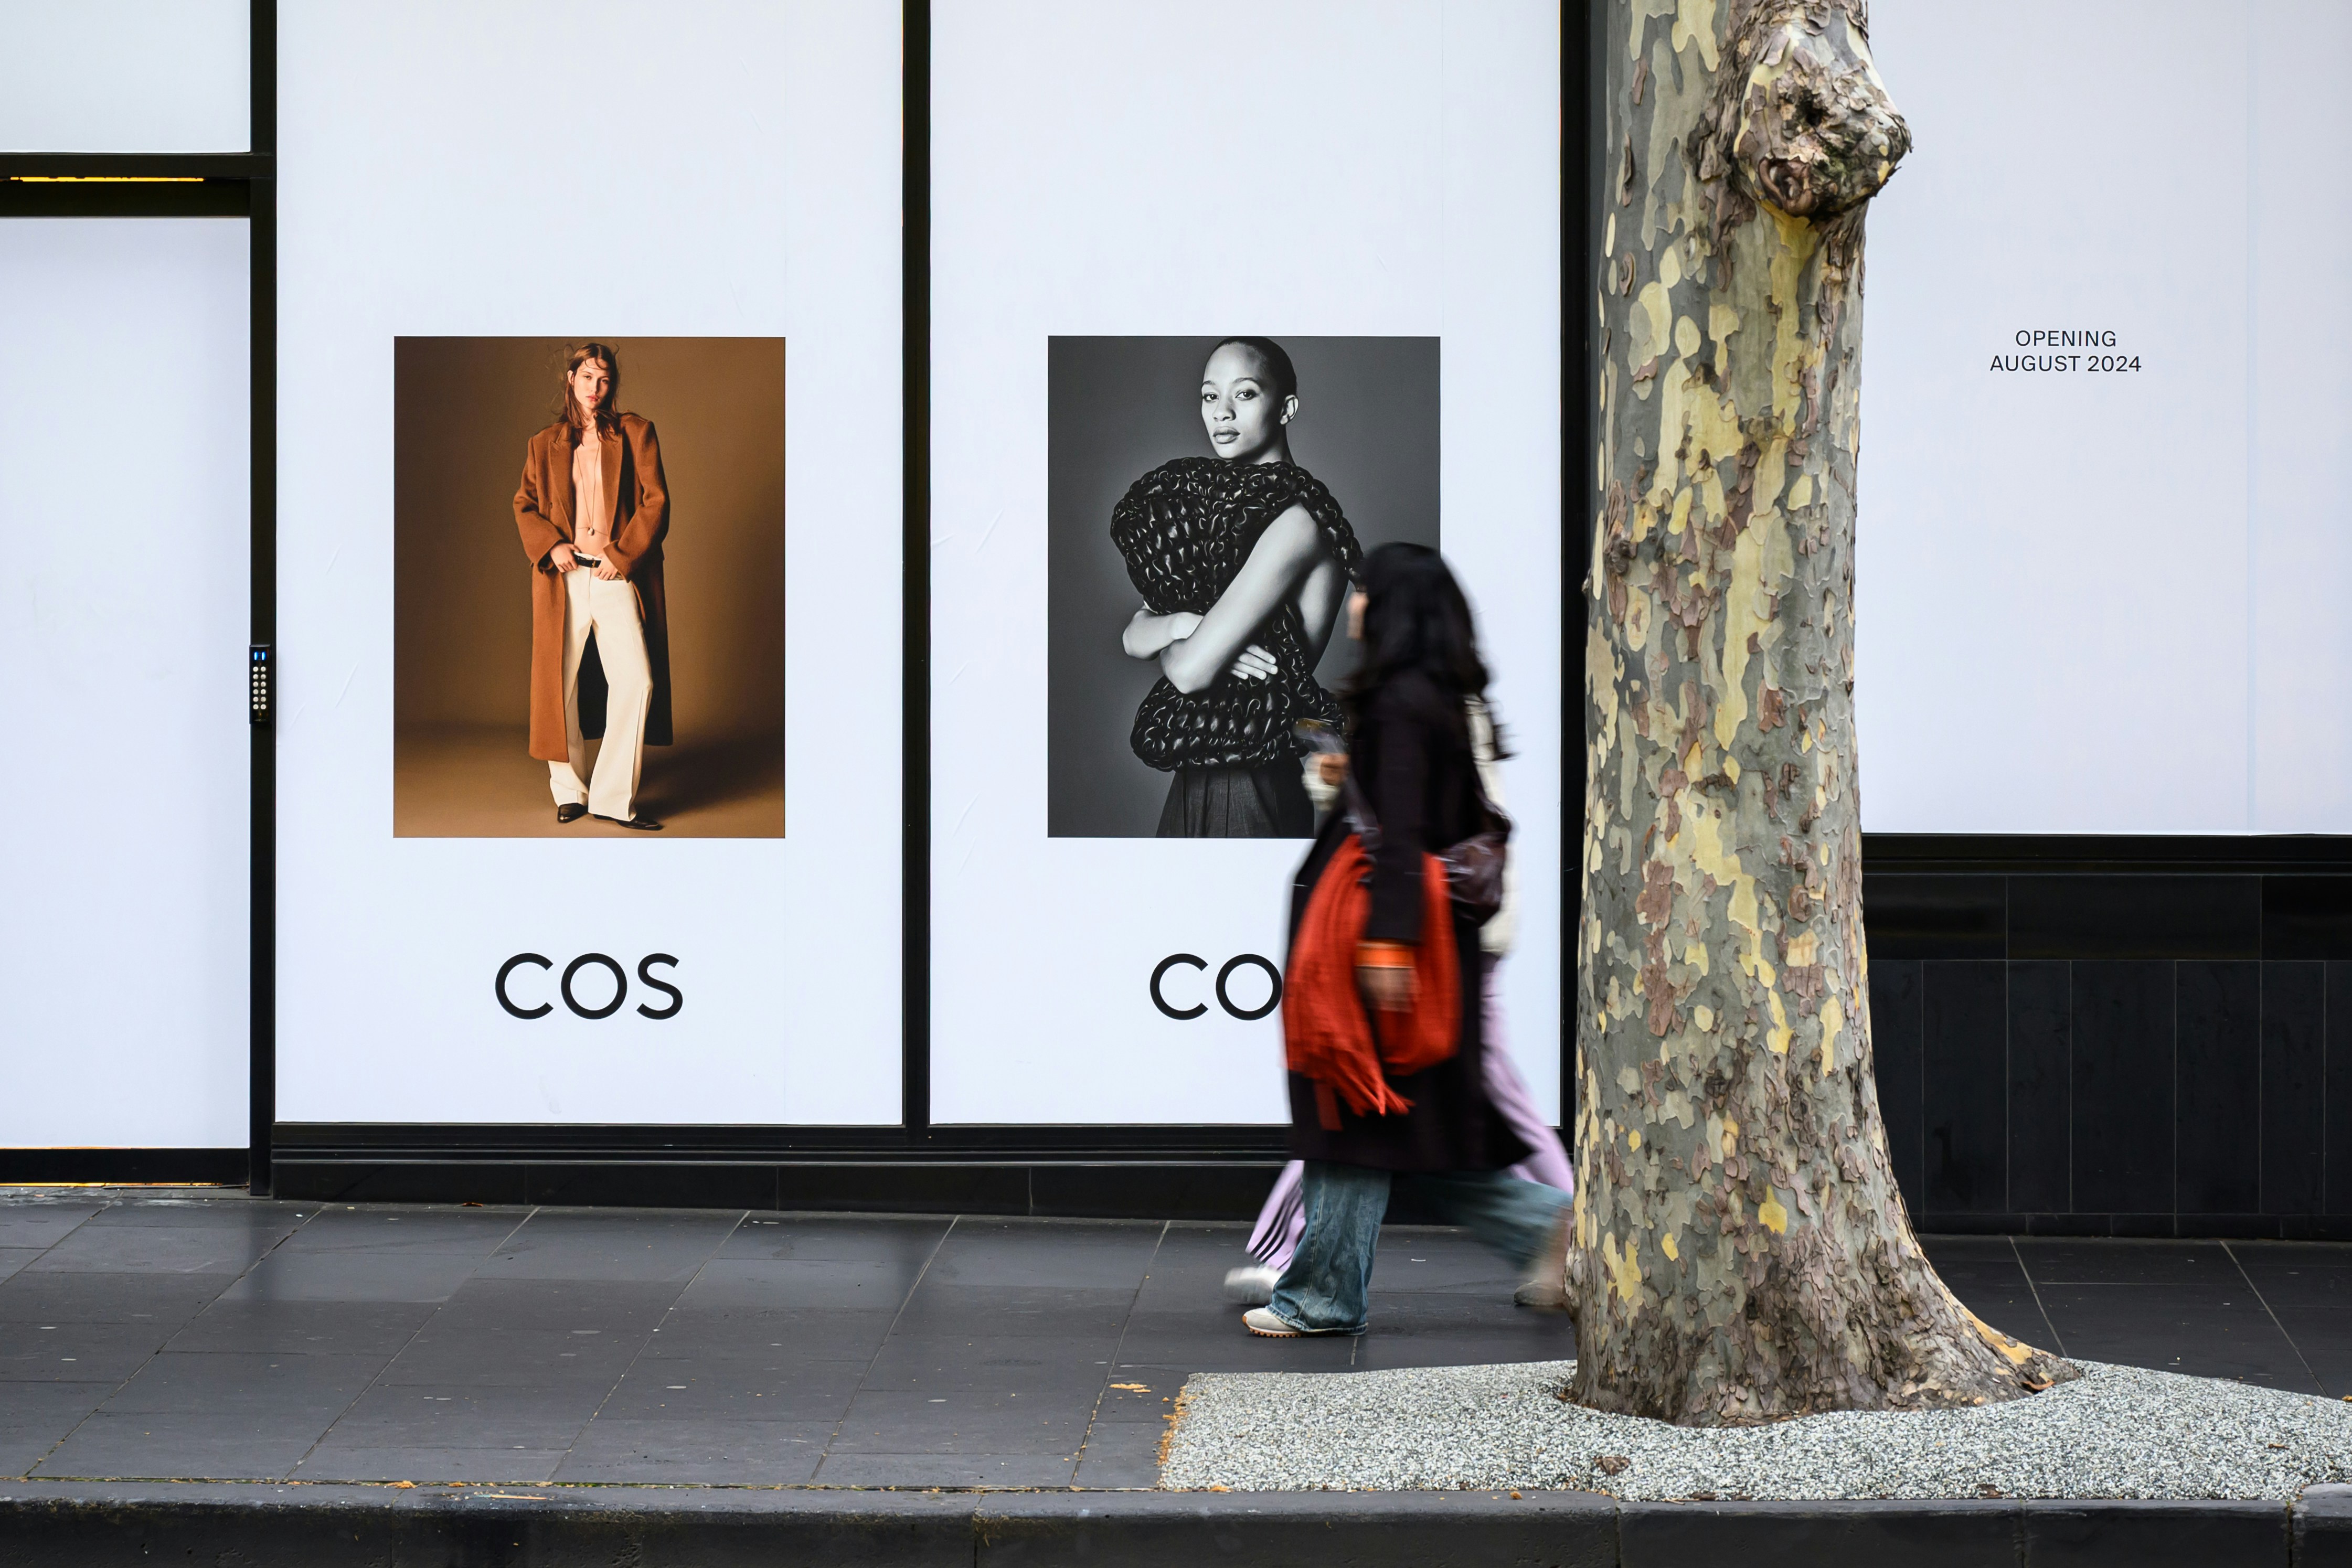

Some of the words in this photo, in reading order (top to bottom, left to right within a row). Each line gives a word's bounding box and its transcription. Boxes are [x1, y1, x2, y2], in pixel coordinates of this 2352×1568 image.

[2016, 330, 2116, 347] OPENING
[1989, 355, 2081, 372] AUGUST
[2087, 355, 2142, 372] 2024
[495, 953, 683, 1020] COS
[1150, 953, 1283, 1020] CO
